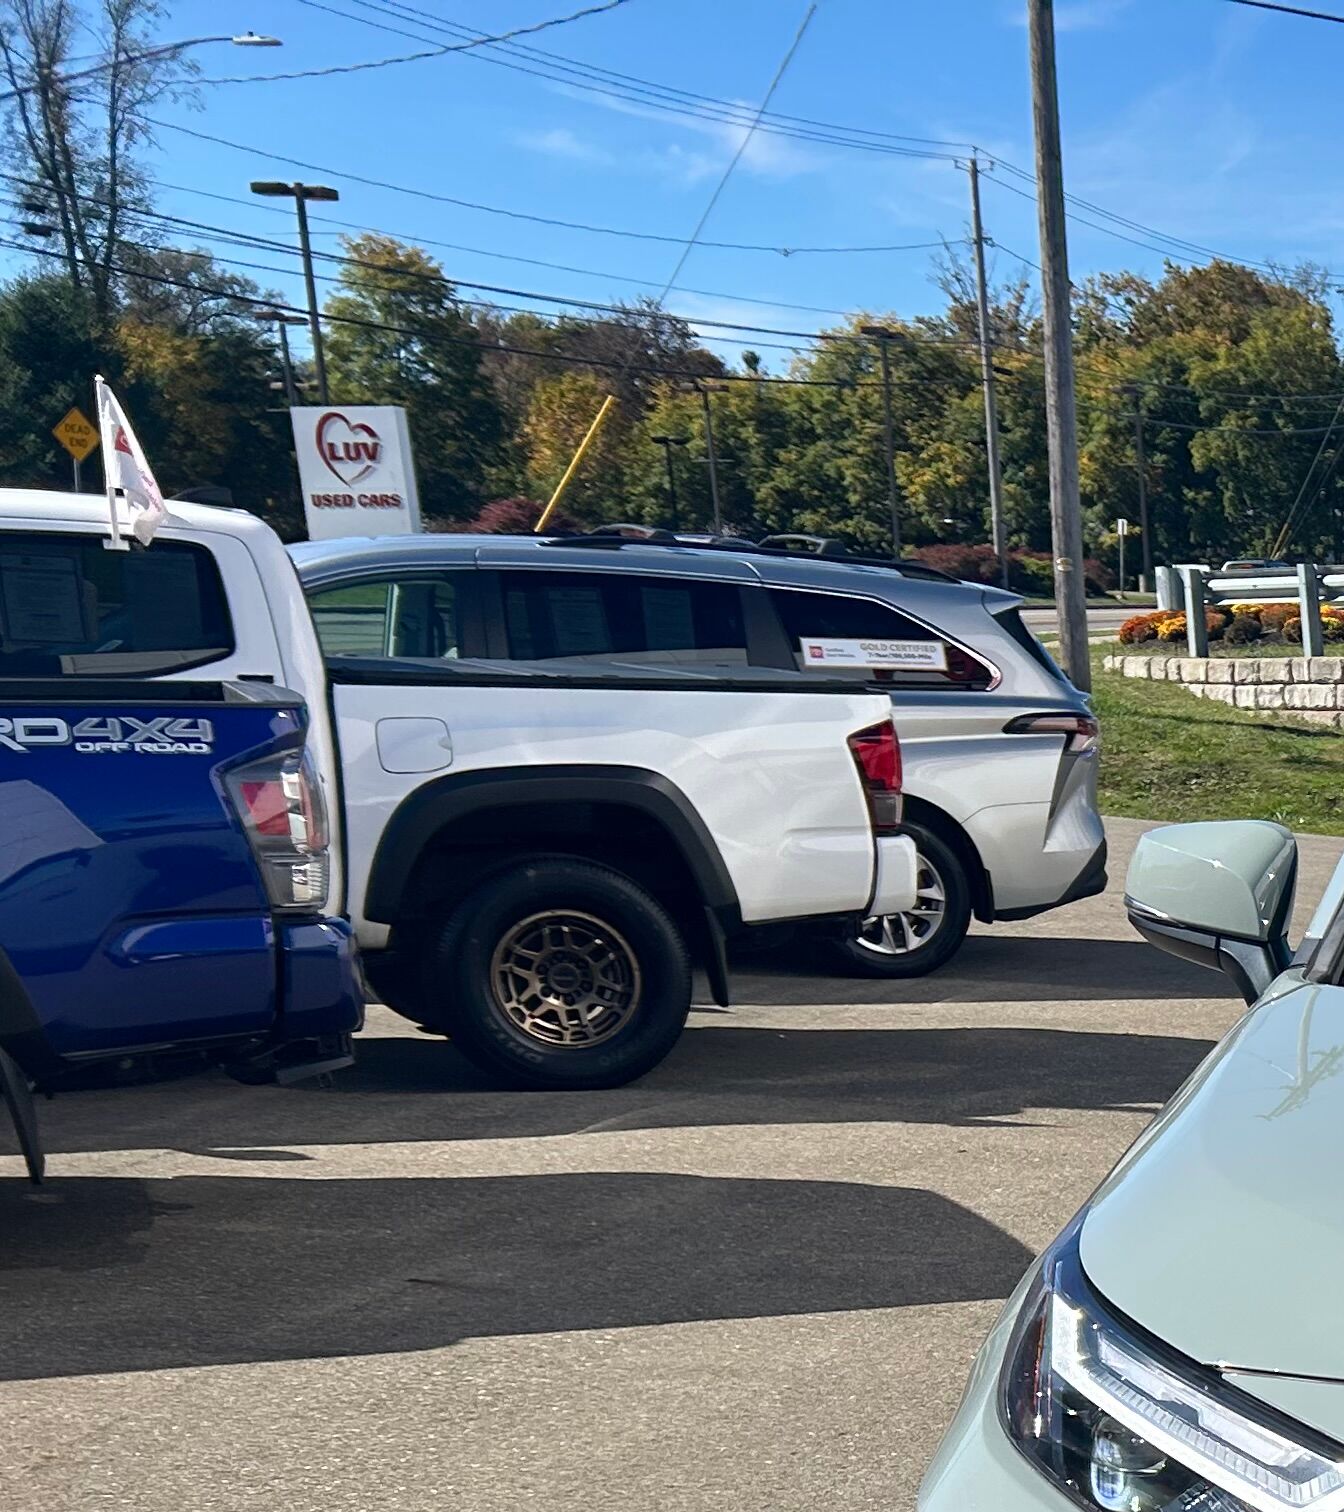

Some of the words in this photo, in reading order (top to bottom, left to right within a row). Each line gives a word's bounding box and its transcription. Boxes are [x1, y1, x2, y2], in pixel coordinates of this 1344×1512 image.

[64, 423, 90, 436] DEAD
[69, 437, 89, 449] END
[326, 442, 381, 463] LUV
[310, 494, 355, 509] USED
[357, 493, 404, 509] CARS
[860, 642, 888, 652] GOLD
[889, 643, 937, 653] CERTIFIED
[0, 717, 71, 752] RD
[72, 717, 213, 743] 4X4
[75, 742, 130, 753] OFF
[134, 742, 212, 754] ROAD
